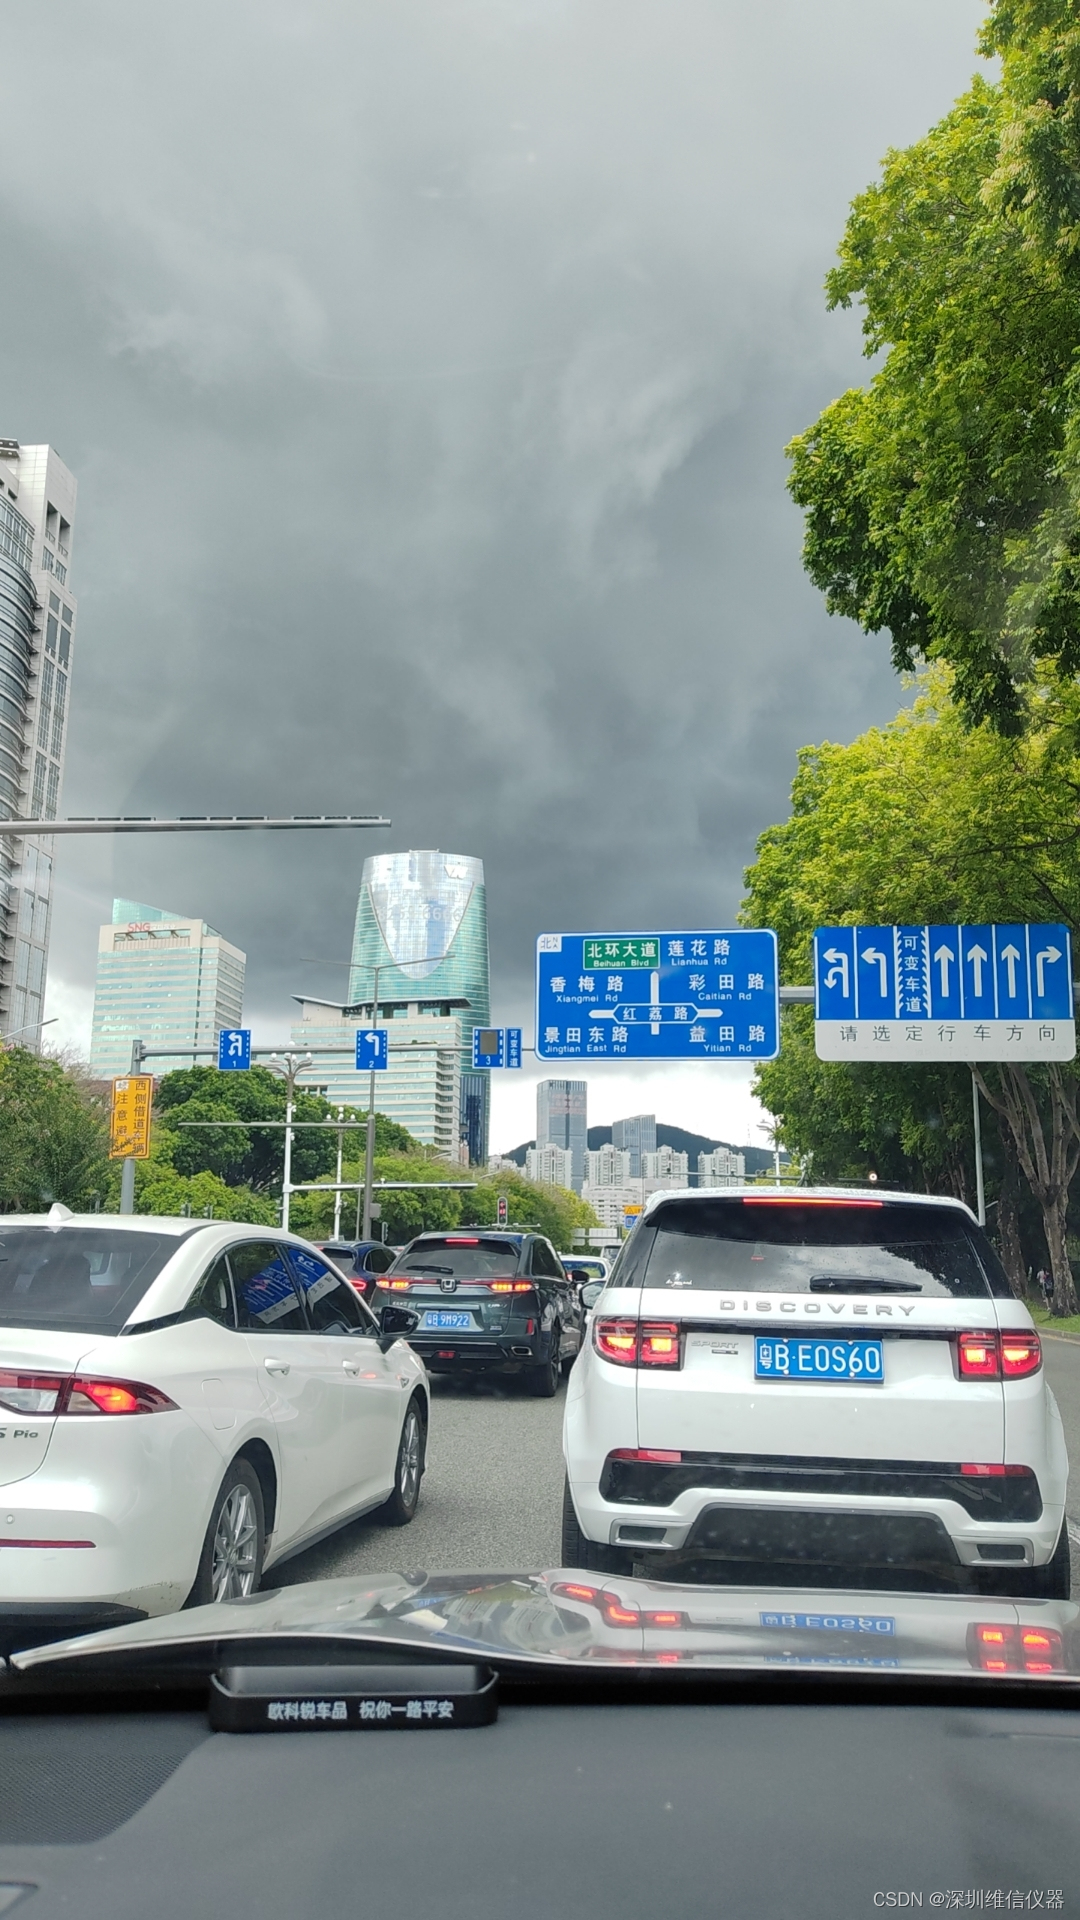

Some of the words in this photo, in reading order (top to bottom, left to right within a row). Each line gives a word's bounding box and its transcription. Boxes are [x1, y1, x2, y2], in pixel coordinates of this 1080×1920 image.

[128, 923, 150, 932] SNG
[541, 937, 551, 949] 北
[668, 939, 730, 957] 莲花路
[587, 942, 656, 958] 北环大道
[631, 959, 650, 967] Blvd
[671, 958, 709, 966] Lianhua
[714, 957, 727, 965] Rd
[903, 935, 922, 1013] 可变车道
[550, 975, 624, 993] 香梅路
[689, 973, 764, 991] 彩田路
[556, 995, 599, 1004] Xiangmei
[605, 994, 618, 1002] Rd
[698, 992, 732, 1001] Caitian
[738, 992, 752, 1001] Rd
[623, 1006, 689, 1021] 红荔路
[544, 1026, 628, 1043] 景田东路
[689, 1025, 765, 1043] 益田路
[840, 1024, 1056, 1042] 请选定行车方向
[509, 1030, 519, 1067] 可变车道
[545, 1045, 581, 1055] Jingtian
[586, 1044, 607, 1052] East
[613, 1045, 627, 1053] Rd
[703, 1044, 731, 1052] Yitian
[738, 1044, 752, 1052] Rd
[232, 1060, 237, 1068] 1
[369, 1060, 375, 1068] 2
[485, 1055, 491, 1065] 3
[720, 1299, 915, 1316] DISCOVERY
[691, 1340, 739, 1349] SPORT
[268, 1701, 347, 1720] 欧科锐车品
[359, 1700, 455, 1719] 祝你一路平安
